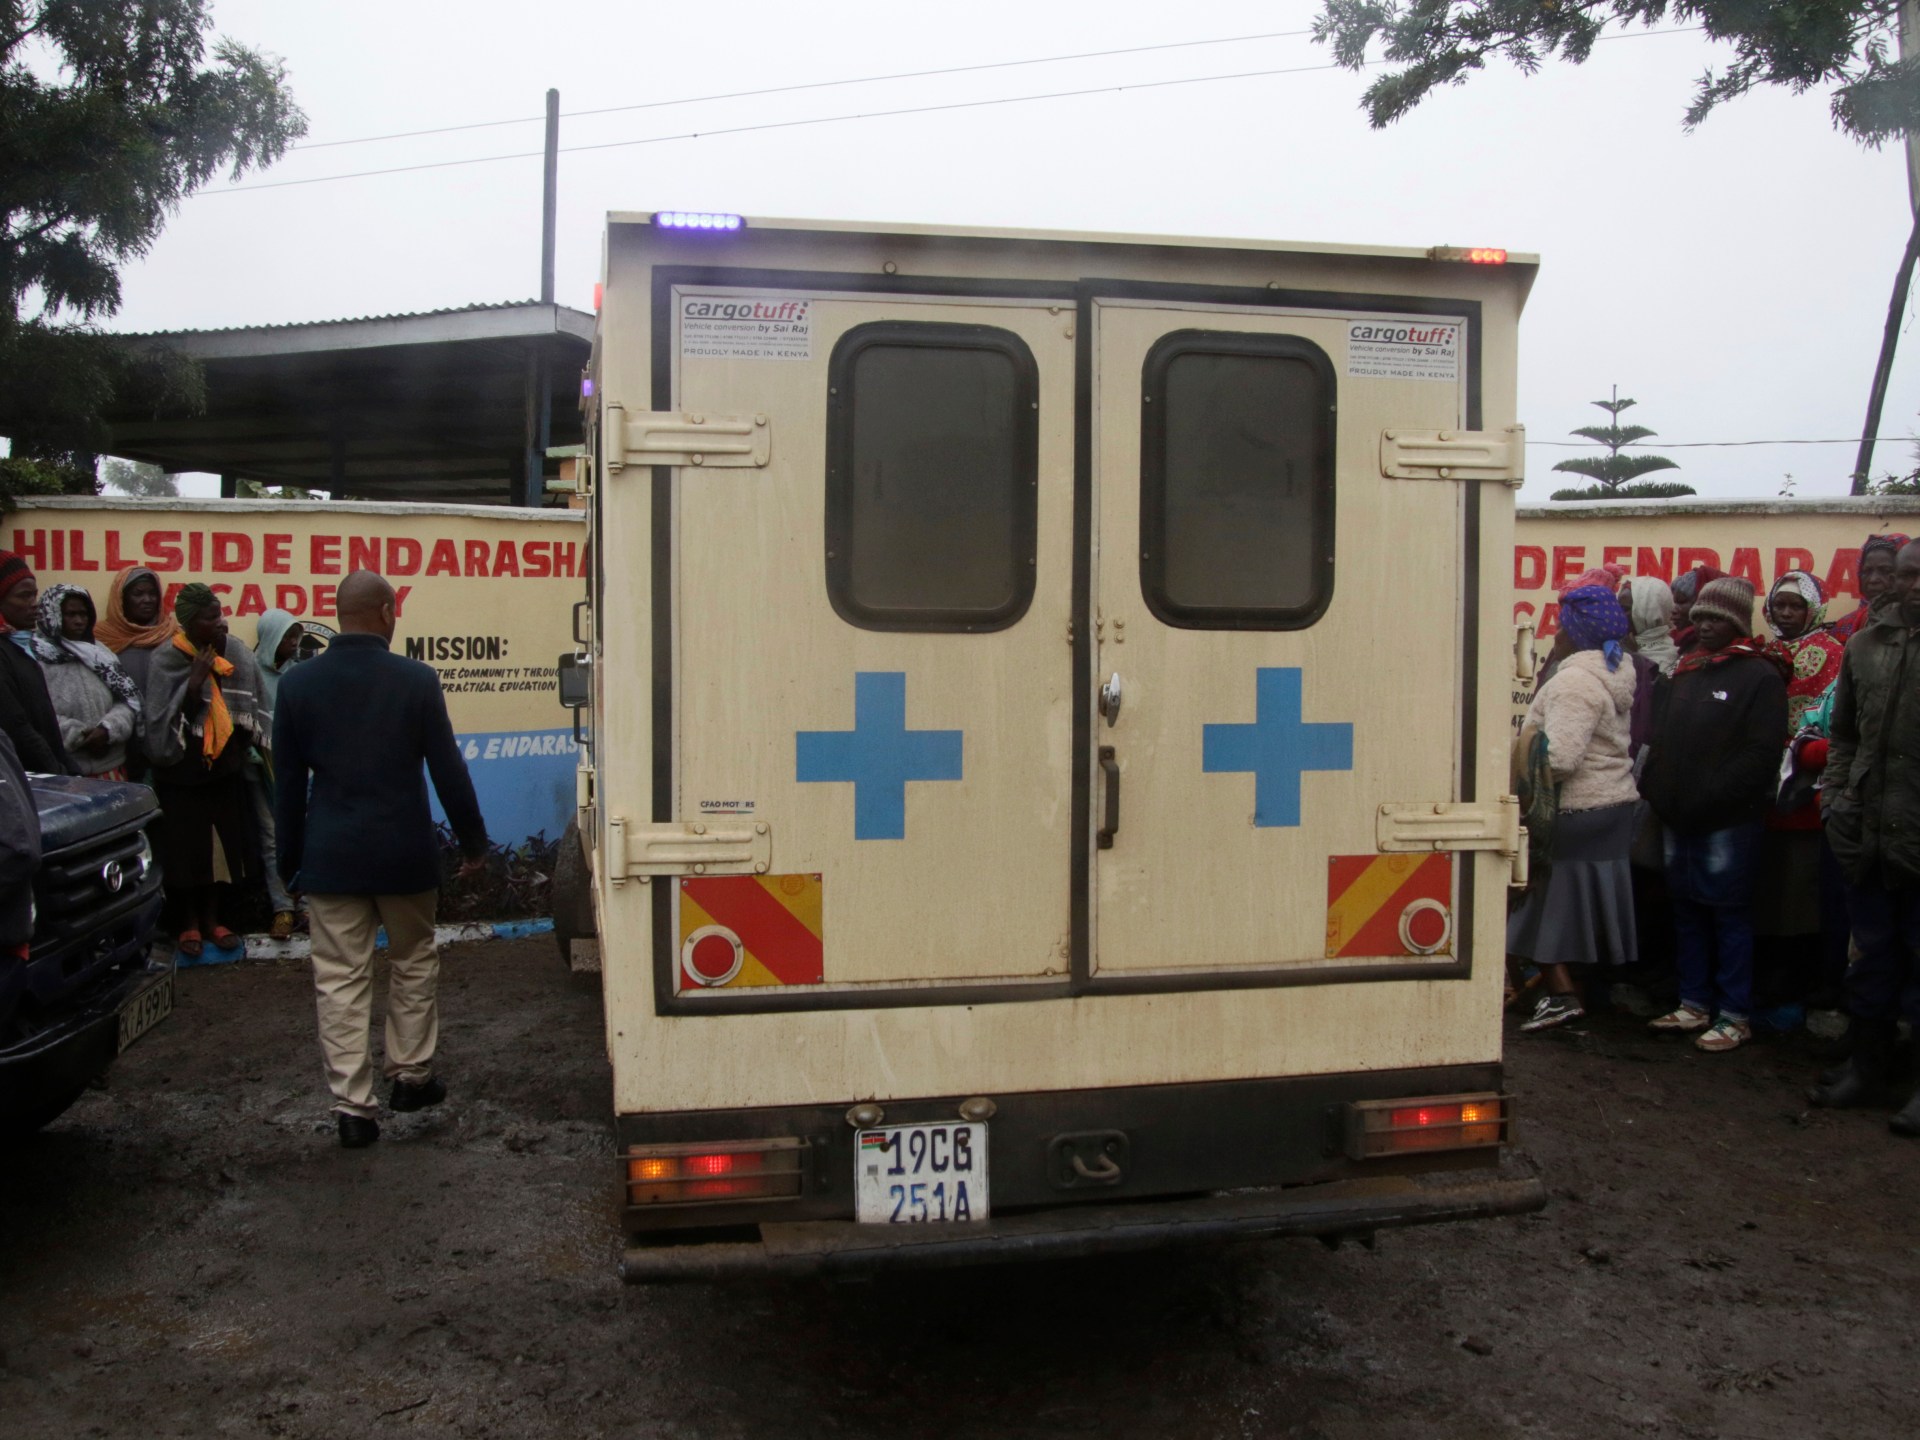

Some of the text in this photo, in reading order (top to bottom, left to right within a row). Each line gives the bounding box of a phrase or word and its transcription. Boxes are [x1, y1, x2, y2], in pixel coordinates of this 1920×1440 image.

[684, 322, 808, 335] Vehicle conversion by Sai Raj
[684, 348, 729, 356] PROUDLY
[1349, 344, 1455, 358] Vehicle conversion by Sai Raj
[1349, 367, 1388, 376] PROUDLY
[1390, 369, 1414, 377] MADE
[1428, 370, 1455, 379] KENYA
[13, 528, 293, 574] HILLSIDE
[405, 636, 509, 661] MISSION:
[436, 668, 457, 680] THE
[457, 667, 520, 679] COMMUNITY
[441, 680, 557, 693] PRACTICAL EDUCATION
[889, 1180, 971, 1224] 251A
